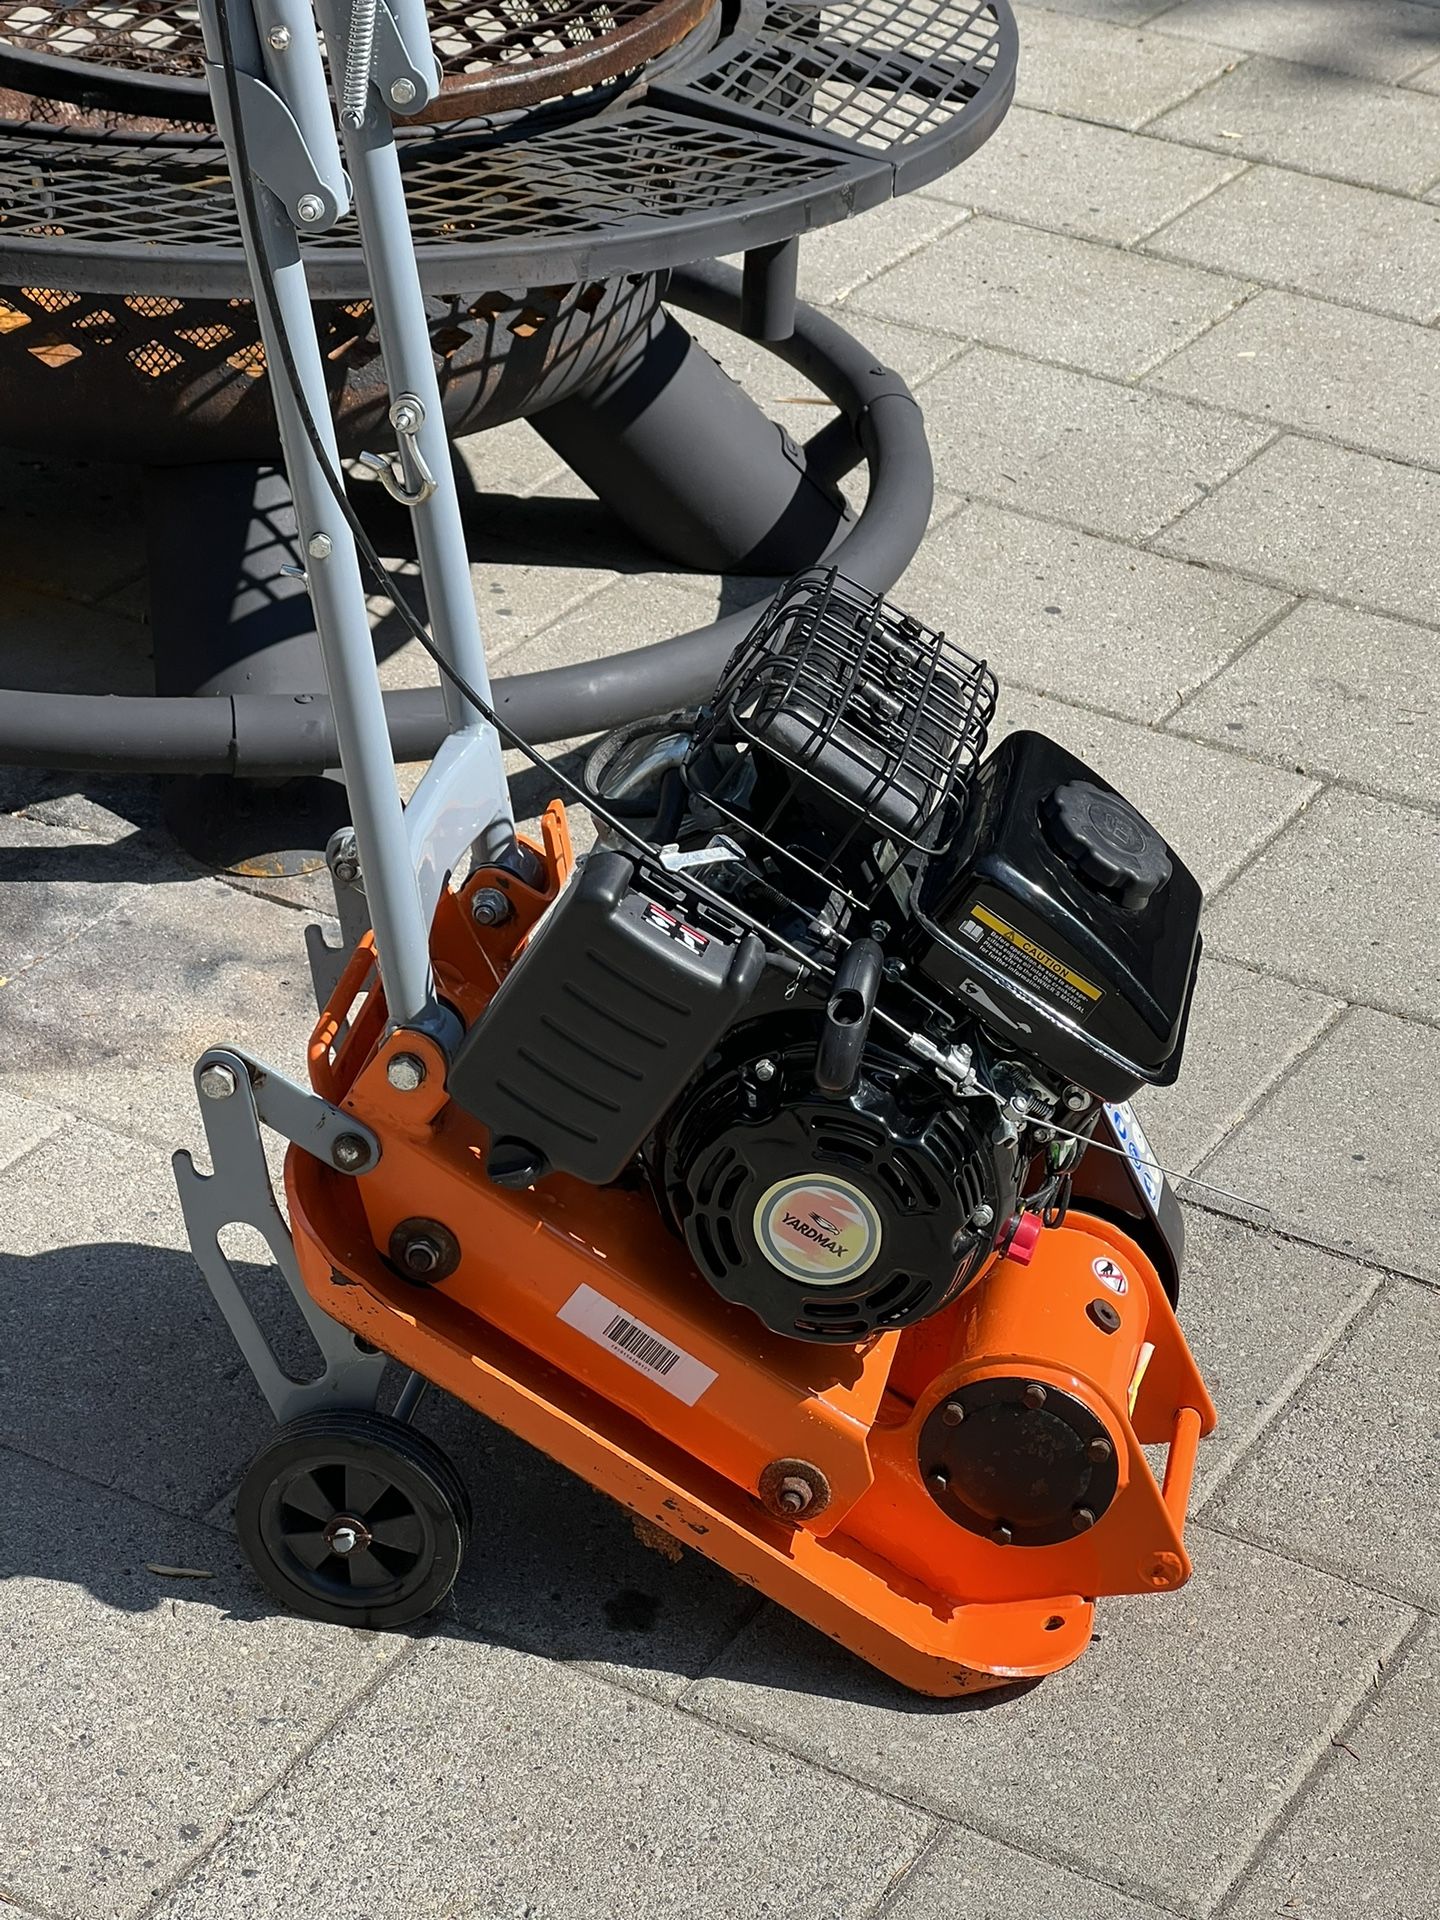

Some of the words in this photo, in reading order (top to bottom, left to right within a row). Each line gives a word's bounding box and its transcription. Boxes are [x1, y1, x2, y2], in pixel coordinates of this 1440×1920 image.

[987, 936, 1003, 949] cified
[1003, 947, 1022, 962] engine
[1031, 967, 1042, 976] into
[988, 951, 1008, 967] further
[991, 931, 1009, 946] Before
[1045, 970, 1057, 980] sure
[1022, 942, 1069, 977] CAUTION
[983, 940, 1002, 955] Please
[1002, 954, 1016, 965] refer
[1060, 993, 1085, 1014] MANUAL
[781, 1212, 848, 1257] YARDMAX
